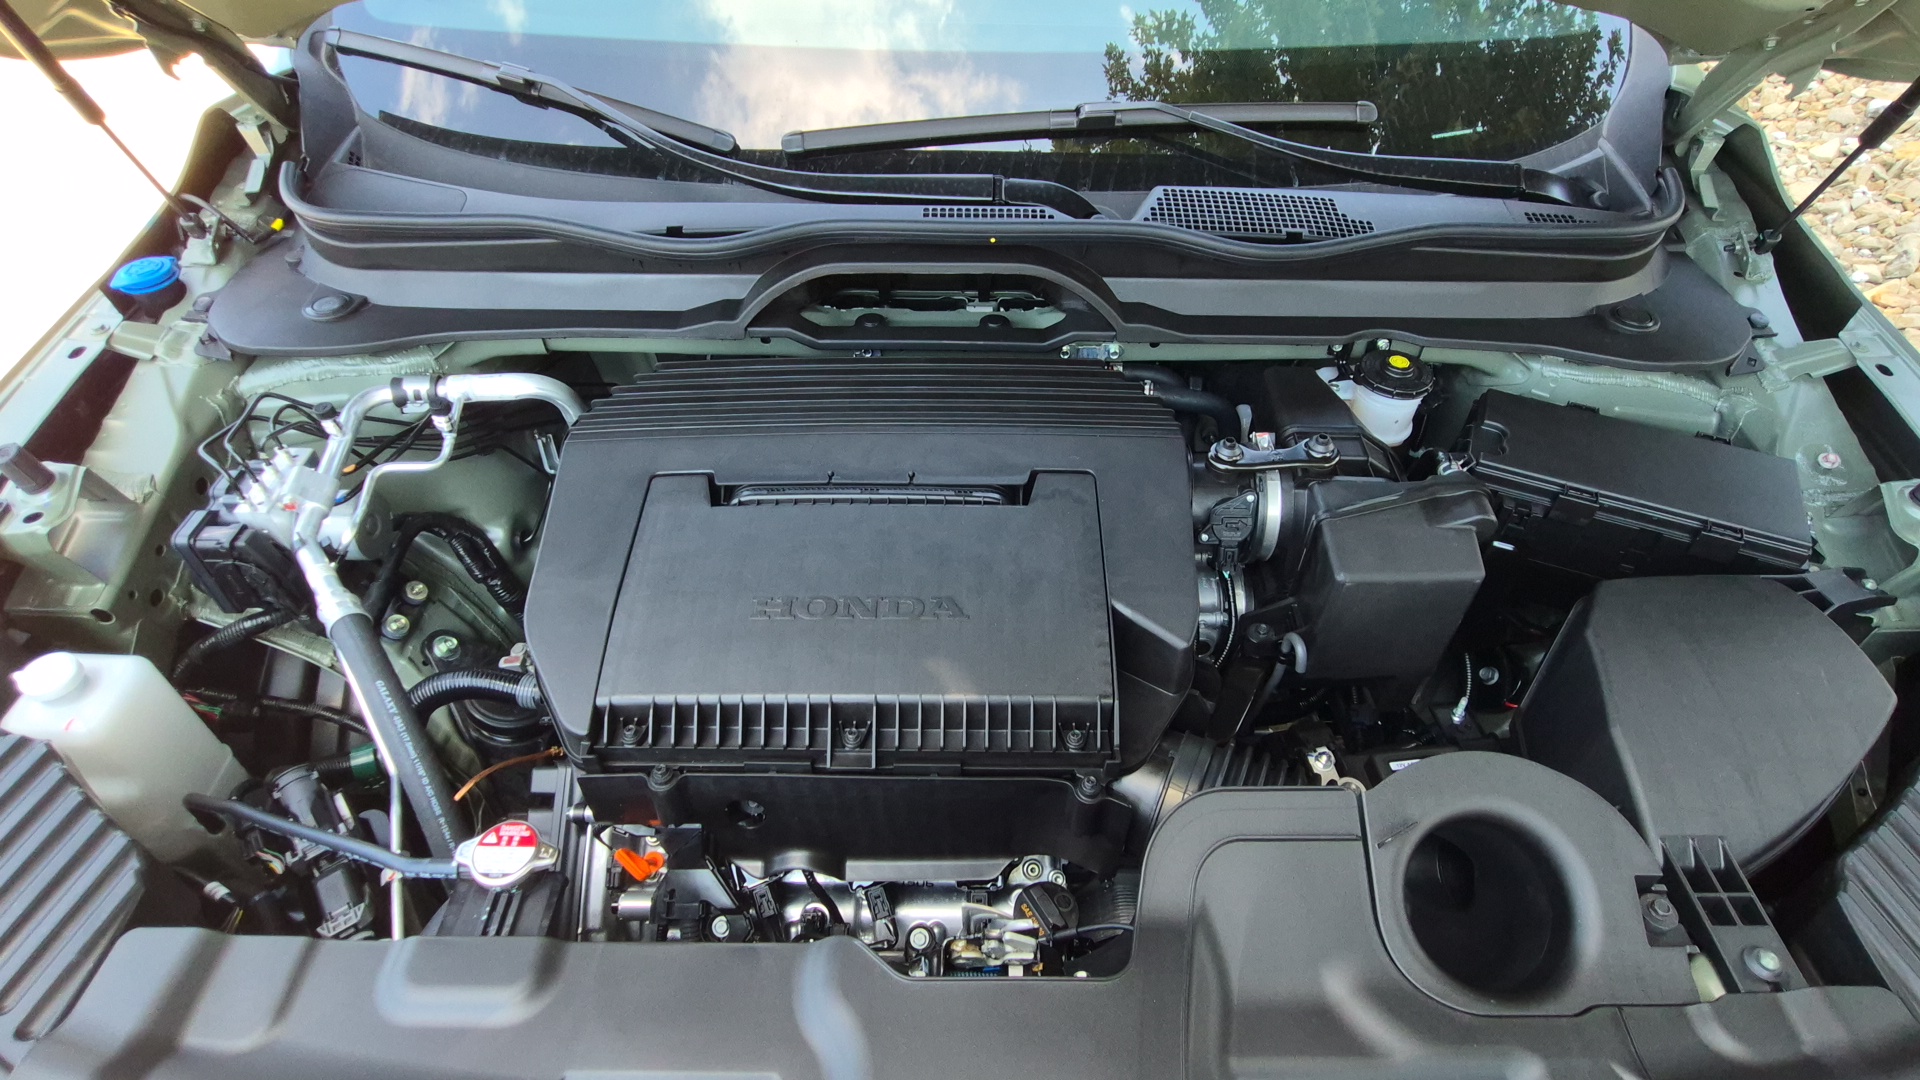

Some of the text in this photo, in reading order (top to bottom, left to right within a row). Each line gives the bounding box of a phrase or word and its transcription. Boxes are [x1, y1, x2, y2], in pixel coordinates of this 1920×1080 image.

[750, 596, 970, 620] HONDA
[375, 680, 396, 714] GALAXY
[429, 797, 442, 815] HOSE
[1020, 903, 1034, 918] SAE
